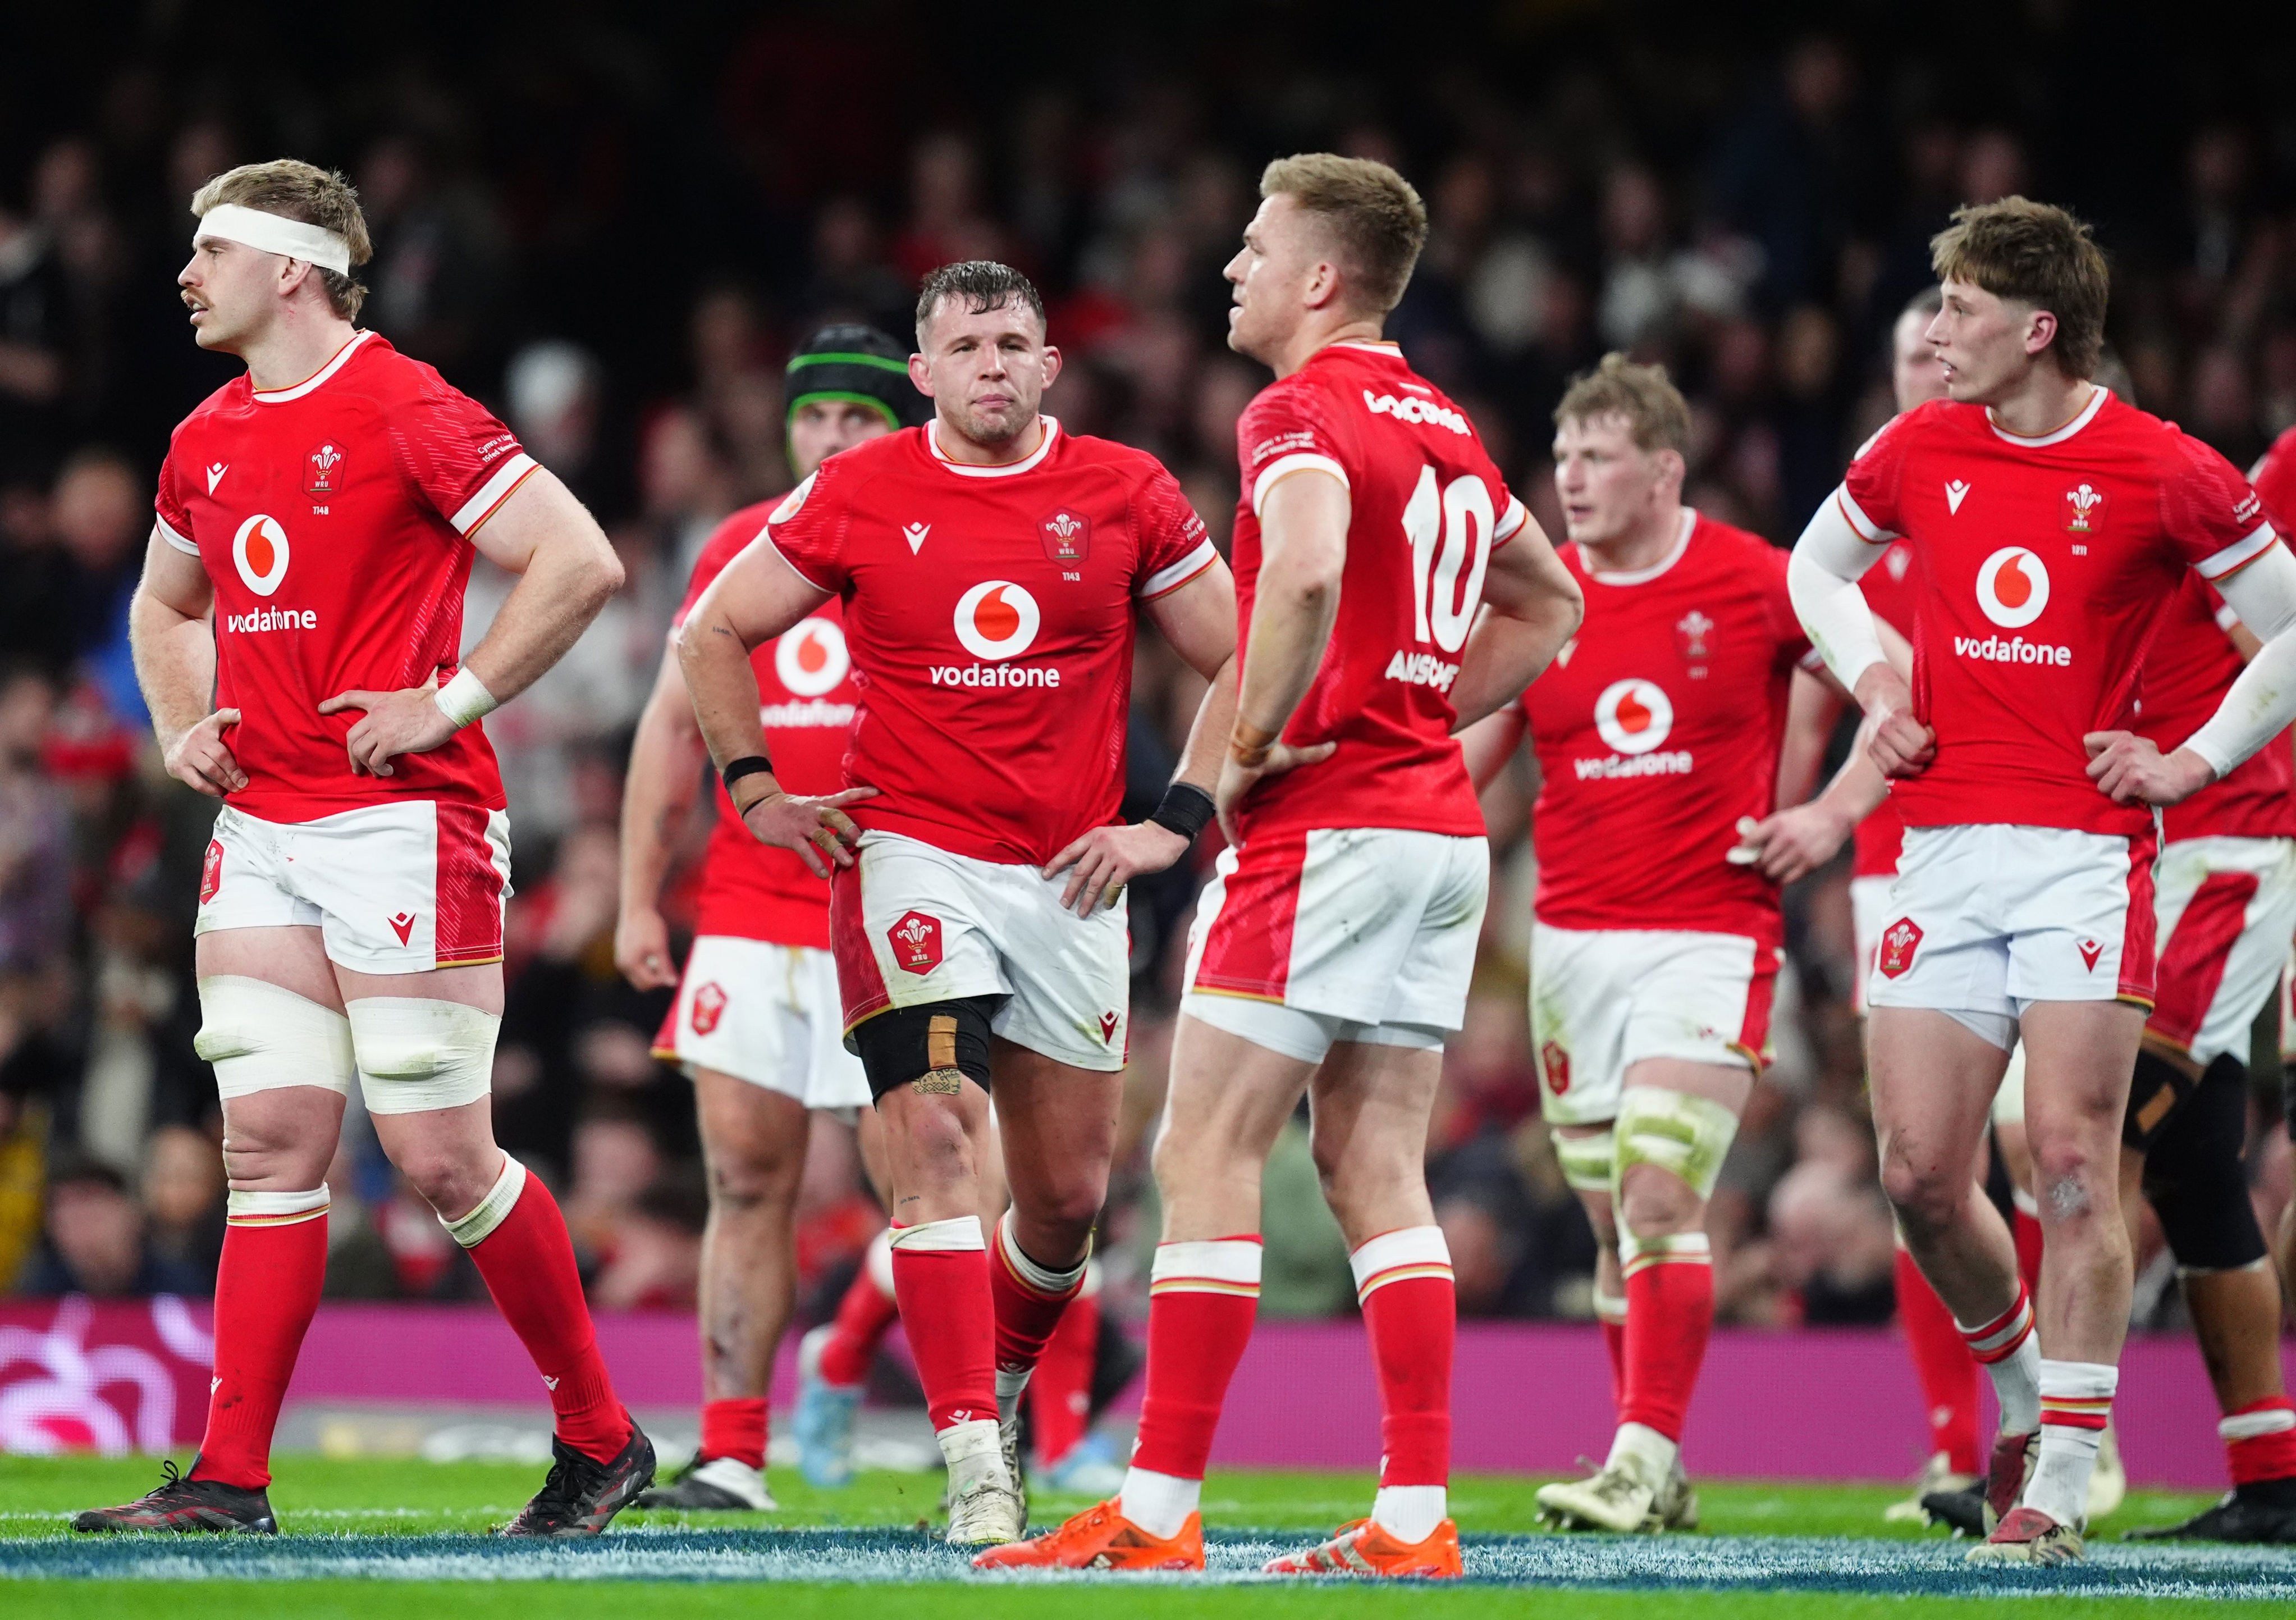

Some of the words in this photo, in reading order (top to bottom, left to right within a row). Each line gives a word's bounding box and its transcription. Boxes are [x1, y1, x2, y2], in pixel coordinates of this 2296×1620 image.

[477, 439, 498, 454] Cymru
[312, 505, 329, 515] 1148
[1401, 463, 1495, 653] 10
[1062, 572, 1081, 582] 1143
[228, 605, 317, 633] vodafone
[1954, 635, 2071, 667] vodafone
[929, 663, 1060, 688] vodafone
[1574, 750, 1693, 781] vodafone
